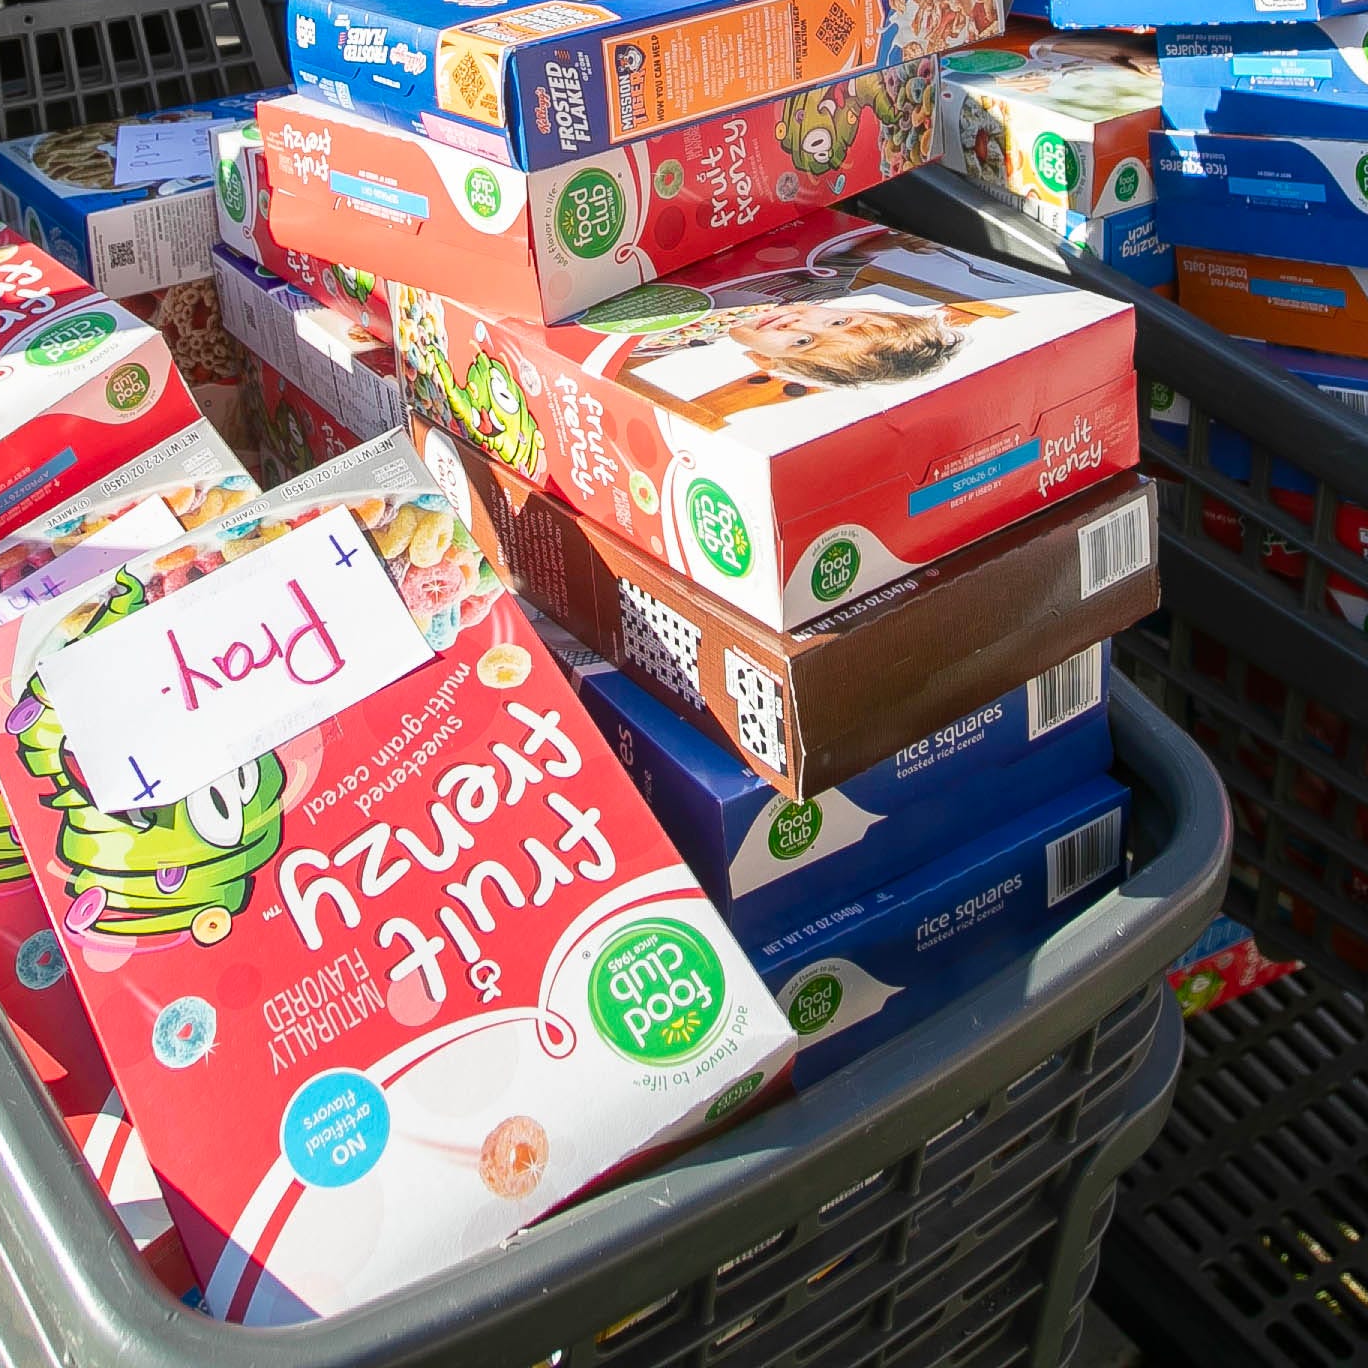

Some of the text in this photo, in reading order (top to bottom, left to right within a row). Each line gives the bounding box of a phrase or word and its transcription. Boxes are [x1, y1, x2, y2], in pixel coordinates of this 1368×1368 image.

[344, 44, 389, 64] FROSTED
[1165, 43, 1209, 57] squares
[620, 73, 635, 132] MISSION
[631, 68, 650, 129] TIGER
[650, 34, 666, 122] HOW YOU CAN HELP
[536, 87, 551, 135] Kellogg's
[545, 61, 578, 153] FROSTED
[563, 64, 593, 145] FLAKES
[283, 124, 333, 156] frenzy
[1043, 141, 1056, 178] club
[1054, 144, 1067, 187] food
[295, 153, 330, 184] fruit
[472, 177, 495, 193] club
[696, 145, 735, 228] fruit
[723, 118, 761, 226] frenzy
[1160, 158, 1228, 180] rice squares
[470, 191, 497, 211] food
[569, 187, 593, 248] food
[591, 183, 611, 238] club
[1208, 262, 1248, 281] toasted
[39, 319, 92, 350] club
[45, 326, 106, 363] food
[112, 370, 139, 393] club
[116, 380, 147, 406] food
[554, 373, 596, 500] frenzy
[579, 392, 619, 487] fruit
[1042, 416, 1093, 468] fruit
[99, 431, 200, 497] NET WT 12.2 OZ (345g)
[280, 439, 394, 501] NET WT 12.2 OZ (345g)
[1037, 440, 1105, 498] frenzy
[46, 504, 78, 529] PAREVE
[499, 497, 507, 528] Value
[950, 493, 967, 509] BEST
[974, 485, 990, 500] USED
[989, 479, 1003, 493] BY
[700, 494, 719, 553] club
[719, 499, 742, 570] food
[819, 548, 852, 577] food
[821, 567, 851, 591] club
[791, 578, 920, 644] NET WT 12.25 OZ (347g)
[162, 579, 347, 712] Pray.
[302, 662, 472, 826] multi-grain cereal
[896, 738, 930, 766] rice
[935, 703, 1003, 748] squares
[896, 729, 986, 780] toasted rice cereal
[354, 716, 463, 819] sweetened
[777, 806, 813, 834] food
[779, 824, 812, 847] club
[378, 792, 617, 1004] fruit
[915, 912, 950, 941] rice
[954, 873, 1023, 922] squares
[762, 903, 865, 957] NET WT 12 OZ (340g)
[916, 902, 1005, 953] toasted rice cereal
[607, 933, 659, 974] since 1945
[609, 942, 684, 1006] club
[263, 947, 371, 1033] FLAVORED
[623, 969, 713, 1049] food
[798, 985, 833, 1012] food
[799, 1002, 832, 1026] club
[266, 978, 386, 1076] NATURALLY
[733, 1005, 749, 1035] add
[672, 1074, 691, 1086] to
[694, 1035, 739, 1078] flavor
[303, 1088, 357, 1131] flavors
[304, 1103, 371, 1157] artificial
[332, 1133, 367, 1166] NO
